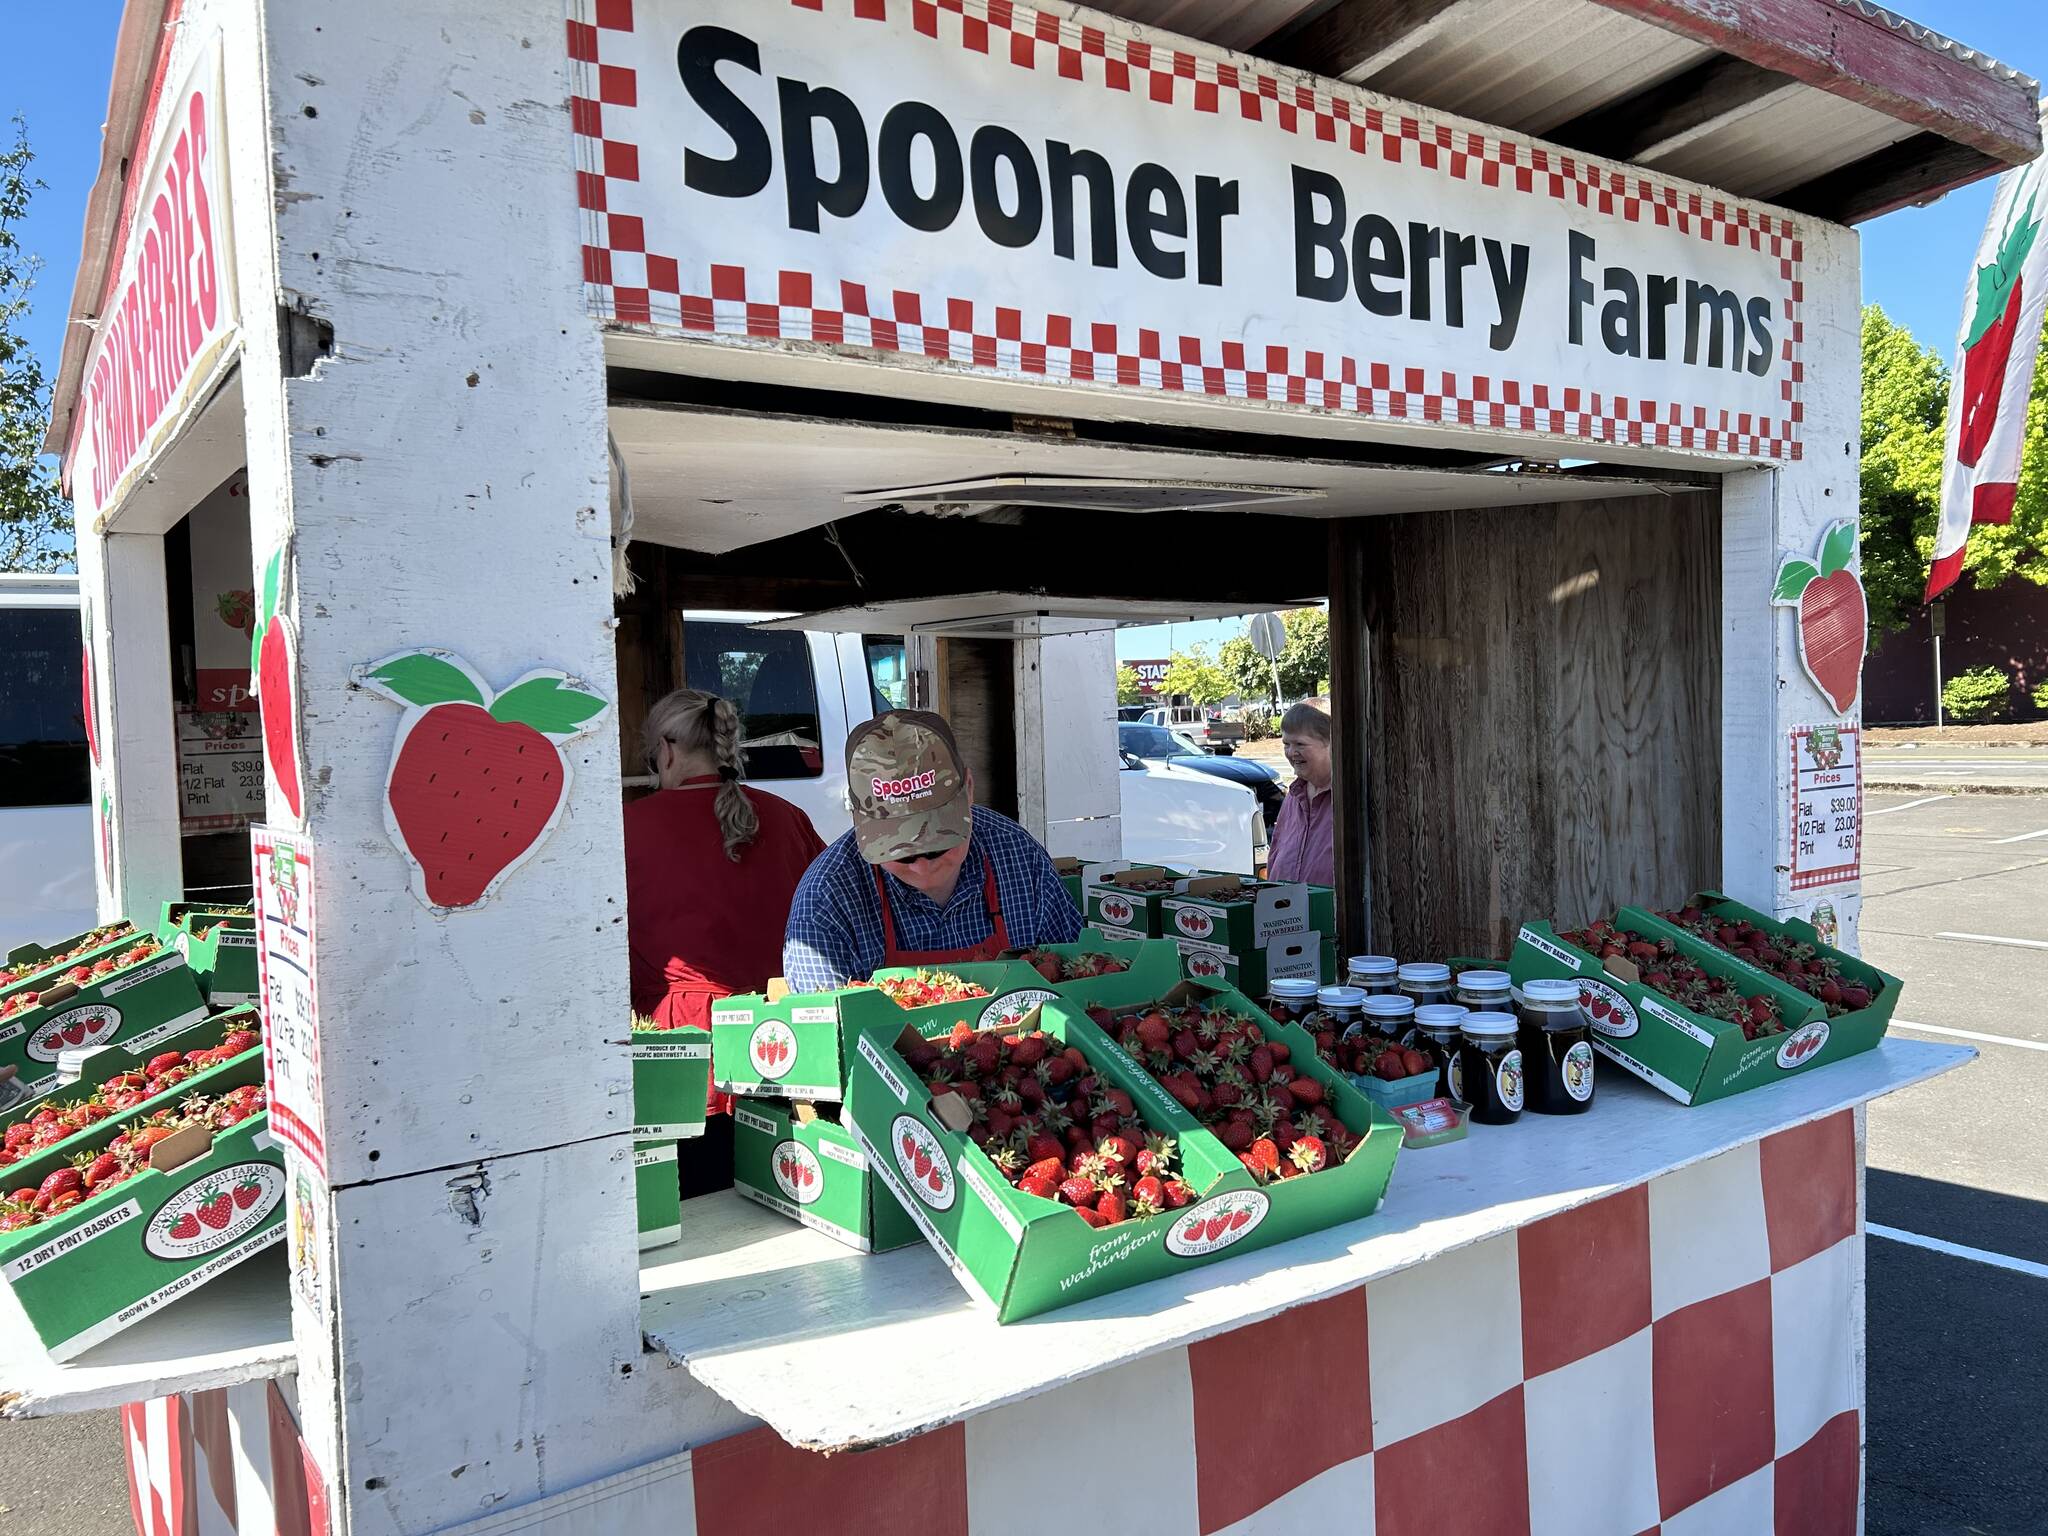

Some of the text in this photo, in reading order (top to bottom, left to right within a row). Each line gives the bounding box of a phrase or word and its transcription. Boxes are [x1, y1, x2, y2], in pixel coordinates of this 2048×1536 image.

[676, 25, 1774, 379] Spooner Berry Farms
[88, 90, 218, 511] STRAWBERRIES
[1137, 664, 1170, 680] STAP
[205, 742, 246, 751] Prices
[182, 763, 204, 775] Flat
[1814, 773, 1841, 785] Prices
[184, 779, 201, 790] 1/2
[204, 778, 225, 789] Flat
[872, 769, 936, 800] Spooner
[187, 793, 210, 805] Pint
[890, 789, 933, 804] Berry Farms
[1799, 797, 1856, 817] Flat $39.00
[1799, 816, 1856, 836] 1/2 Flat 23.00
[1800, 835, 1855, 855] Pint 4.50
[1260, 925, 1303, 937] STRAWBERRIES
[1263, 917, 1302, 928] WASHINGTON
[280, 929, 299, 957] Prices
[1521, 930, 1576, 966] 12 DRY PINT BASKETS
[123, 969, 141, 983] PRODUCE
[149, 965, 158, 973] THE
[1274, 960, 1313, 974] WASHINGTON
[114, 980, 131, 992] PACIFIC
[983, 996, 1013, 1021] SPOONER
[1014, 991, 1039, 1001] BERRY
[1601, 985, 1620, 1002] BERRY
[1619, 999, 1636, 1020] FARMS
[29, 1018, 59, 1046] SPOONER
[59, 1008, 82, 1023] BERRY
[84, 1006, 112, 1018] FARMS
[1650, 1008, 1699, 1039] PACIFIC NORTHWEST U.S.A.
[1661, 1008, 1679, 1021] PRODUCE
[1684, 1020, 1692, 1028] THE
[132, 1028, 158, 1044] OLYMPIA,
[1605, 1042, 1621, 1057] FARMS
[1624, 1055, 1645, 1073] OLYMPIA,
[1739, 1046, 1762, 1067] from
[860, 1040, 904, 1097] 12 DRY PINT BASKETS
[1100, 1037, 1182, 1115] Please Refrigerate
[34, 1075, 57, 1089] PACKED
[750, 1116, 759, 1125] PINT
[900, 1117, 924, 1138] SPOONER
[924, 1132, 940, 1156] BERRY
[644, 1156, 659, 1164] U.S.A.
[899, 1155, 936, 1206] STRAWBERRIES
[149, 1164, 272, 1234] SPOONER BERRY FARMS
[861, 1135, 873, 1152] GROWN
[876, 1153, 890, 1173] PACKED
[895, 1180, 912, 1205] SPOONER
[910, 1198, 923, 1218] BERRY
[922, 1215, 936, 1237] FARMS
[937, 1236, 956, 1266] OLYMPIA,
[1219, 1192, 1243, 1203] BERRY
[1243, 1192, 1266, 1205] FARMS
[17, 1207, 131, 1273] 12 DRY PINT BASKETS
[186, 1206, 269, 1255] STRAWBERRIES
[1089, 1230, 1132, 1262] from
[1183, 1231, 1242, 1255] STRAWBERRIES
[117, 1300, 150, 1323] GROWN
[150, 1294, 158, 1305] &
[158, 1278, 191, 1300] PACKED
[190, 1268, 206, 1284] BY:
[206, 1250, 244, 1274] SPOONER
[243, 1236, 269, 1255] BERRY
